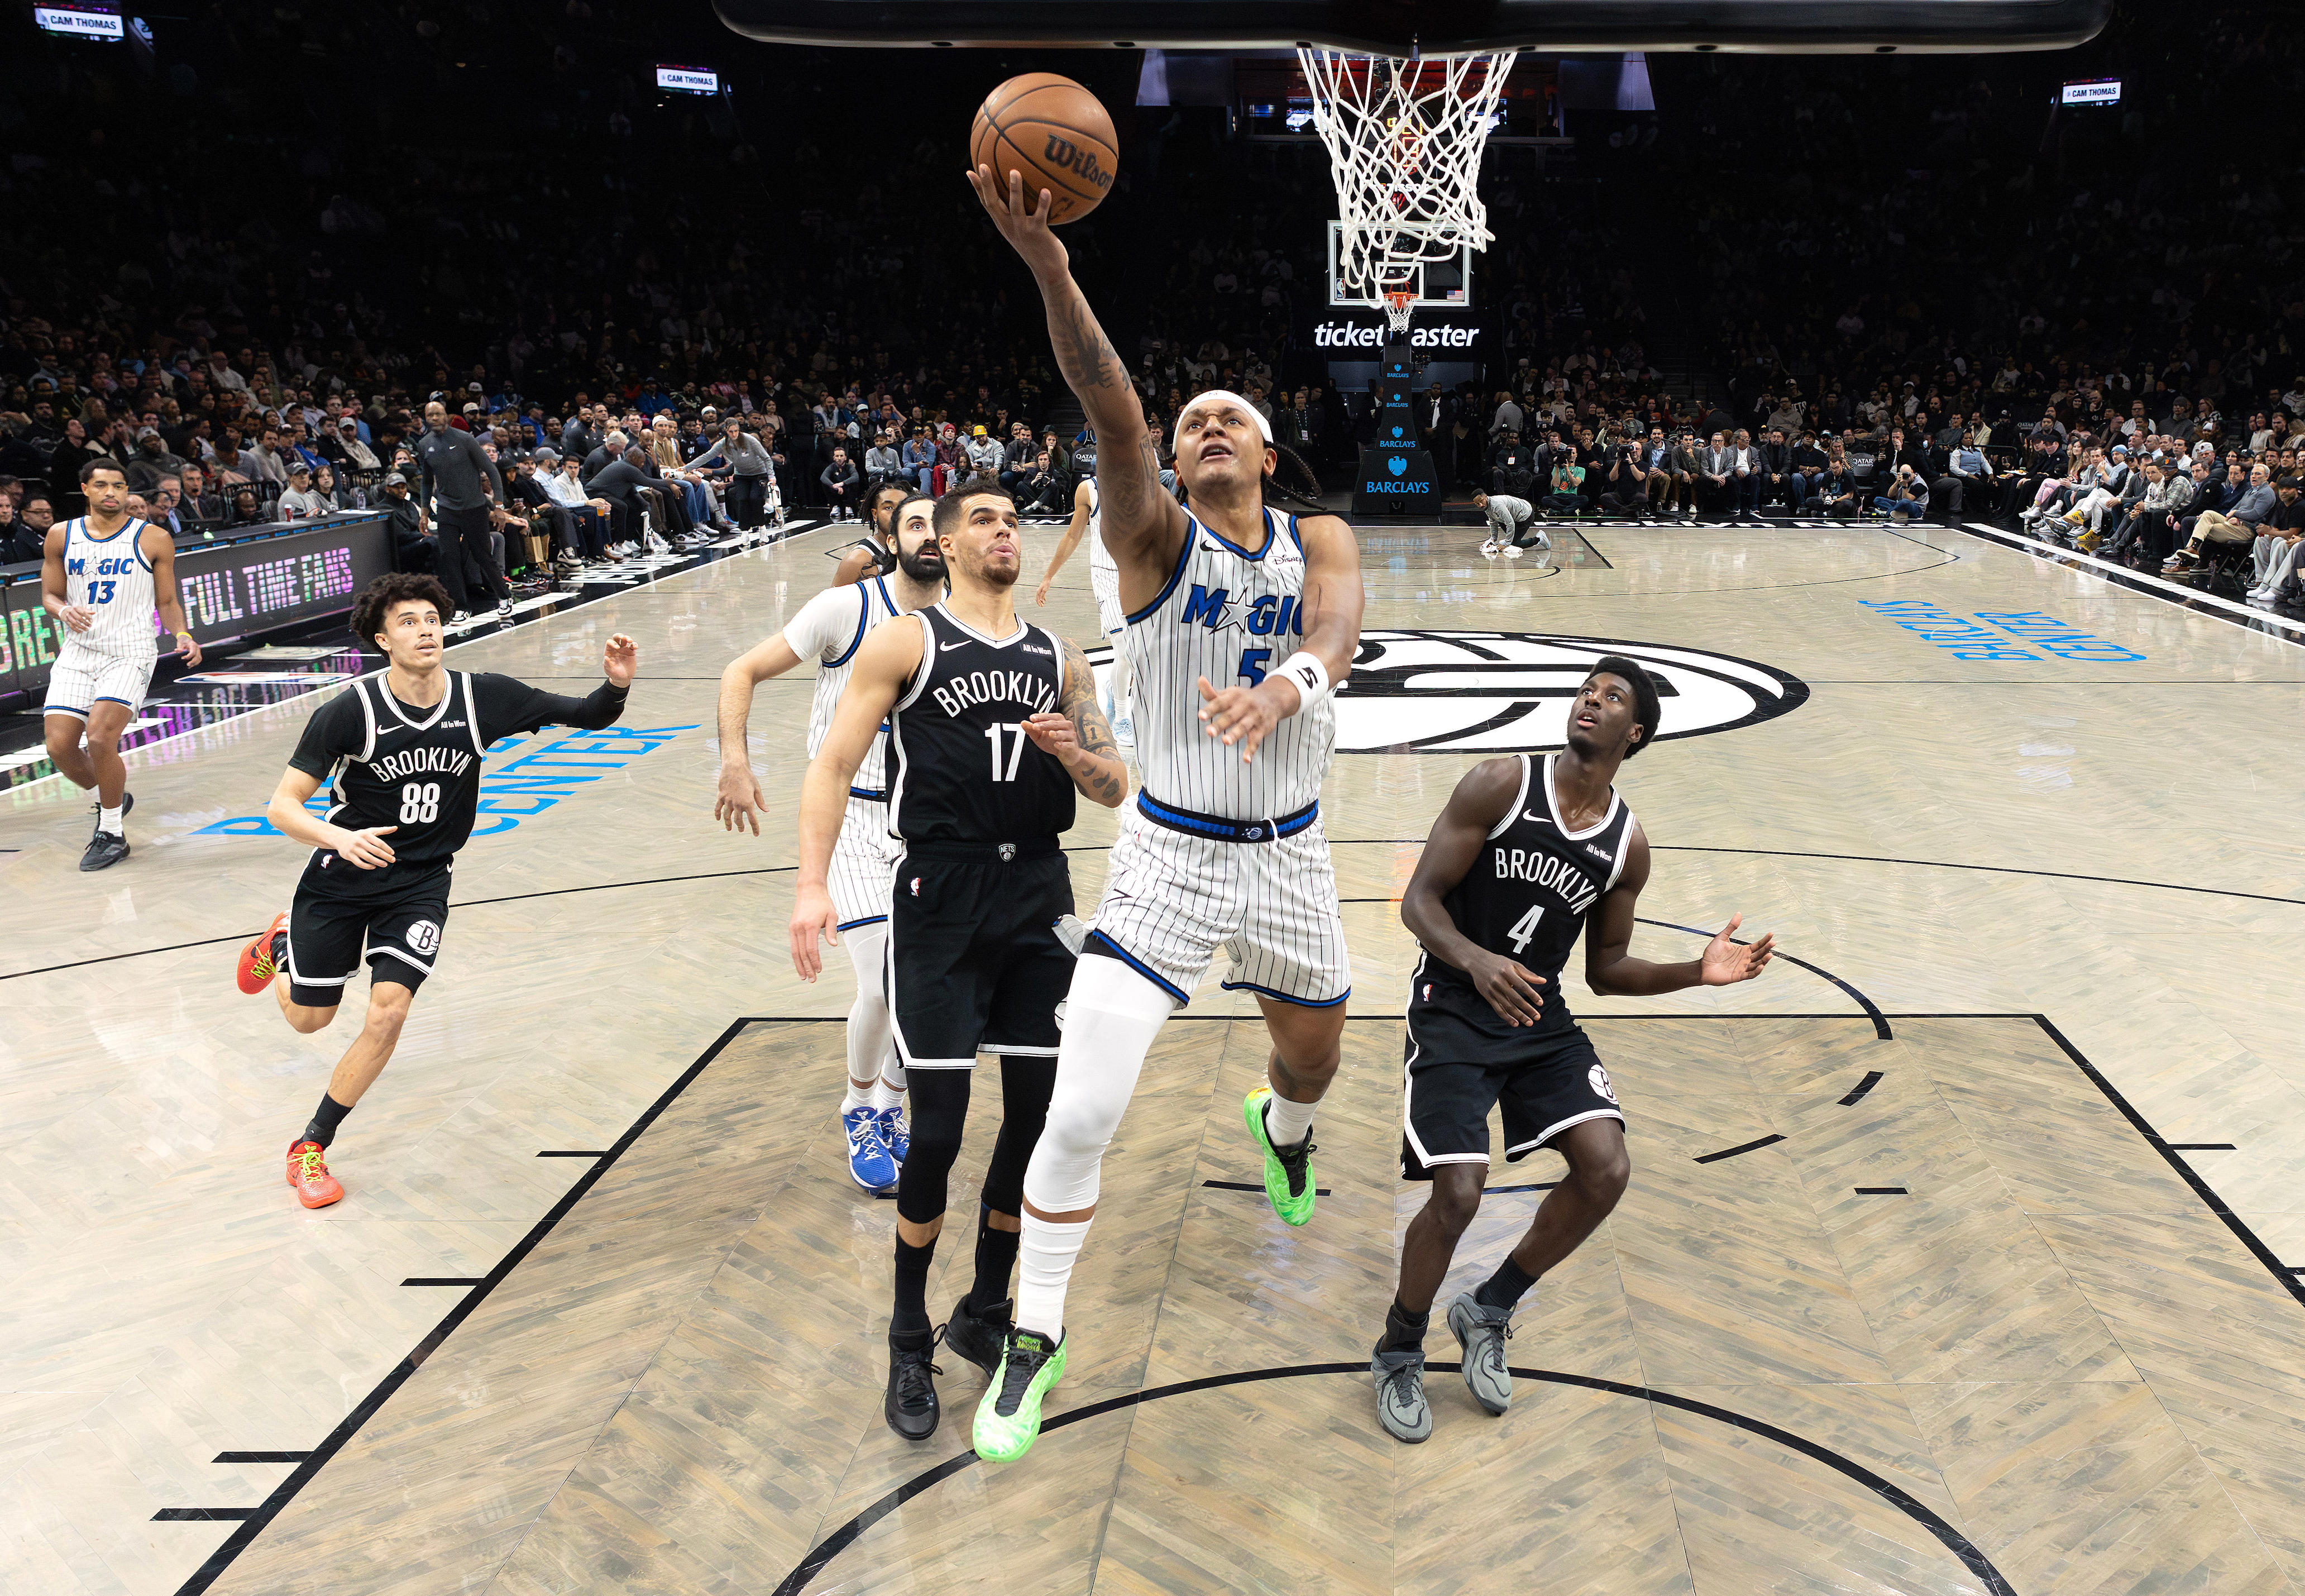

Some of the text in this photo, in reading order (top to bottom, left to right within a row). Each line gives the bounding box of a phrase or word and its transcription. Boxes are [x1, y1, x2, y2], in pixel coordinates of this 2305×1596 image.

[50, 15, 117, 30] CAM THOMAS
[667, 74, 713, 85] CAM THOMAS
[2089, 87, 2116, 96] THOMAS
[1044, 132, 1113, 190] Wilson
[1314, 321, 1480, 347] ticketaster
[1791, 401, 1807, 416] ETS
[1366, 481, 1429, 494] BARCLAYS
[1486, 520, 1777, 528] rooklyn
[87, 581, 116, 604] 13
[180, 568, 243, 630] FULL
[242, 557, 301, 615] TIME
[300, 547, 354, 603] FANS
[1023, 643, 1031, 653] All
[1857, 600, 2045, 661] BARCLAYS
[1973, 611, 2147, 662] CENTER
[1237, 648, 1273, 689] 5
[932, 670, 1055, 718] BROOKLYN
[369, 747, 472, 782] BROOKLYN
[984, 722, 1026, 781] 17
[399, 782, 441, 824] 88
[1000, 845, 1015, 853] NETS
[1495, 848, 1598, 915] BROOKLYN
[1507, 904, 1546, 954] 4
